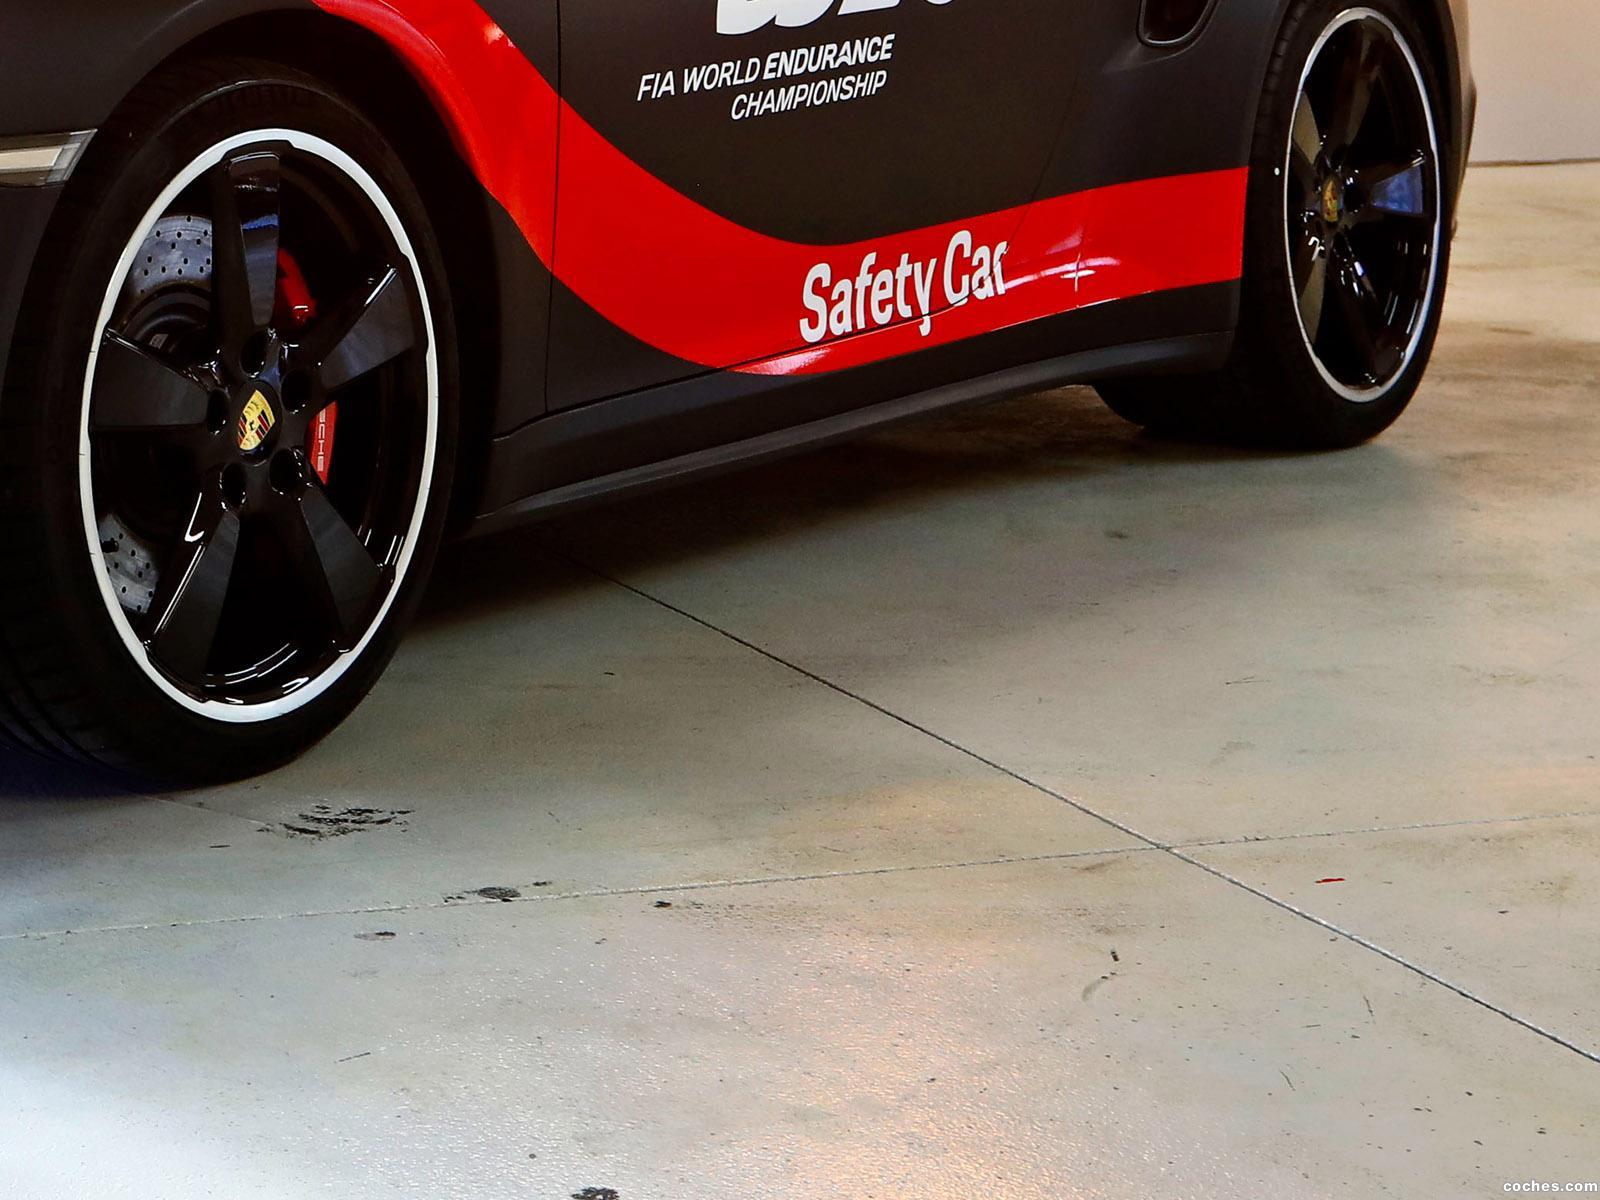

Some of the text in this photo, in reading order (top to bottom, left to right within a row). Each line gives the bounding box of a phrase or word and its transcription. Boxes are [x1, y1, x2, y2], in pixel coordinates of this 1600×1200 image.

[637, 33, 895, 101] FIA WORLD ENDURANCE
[731, 70, 887, 120] CHAMPIONSHIP
[800, 229, 1010, 338] Safety Car
